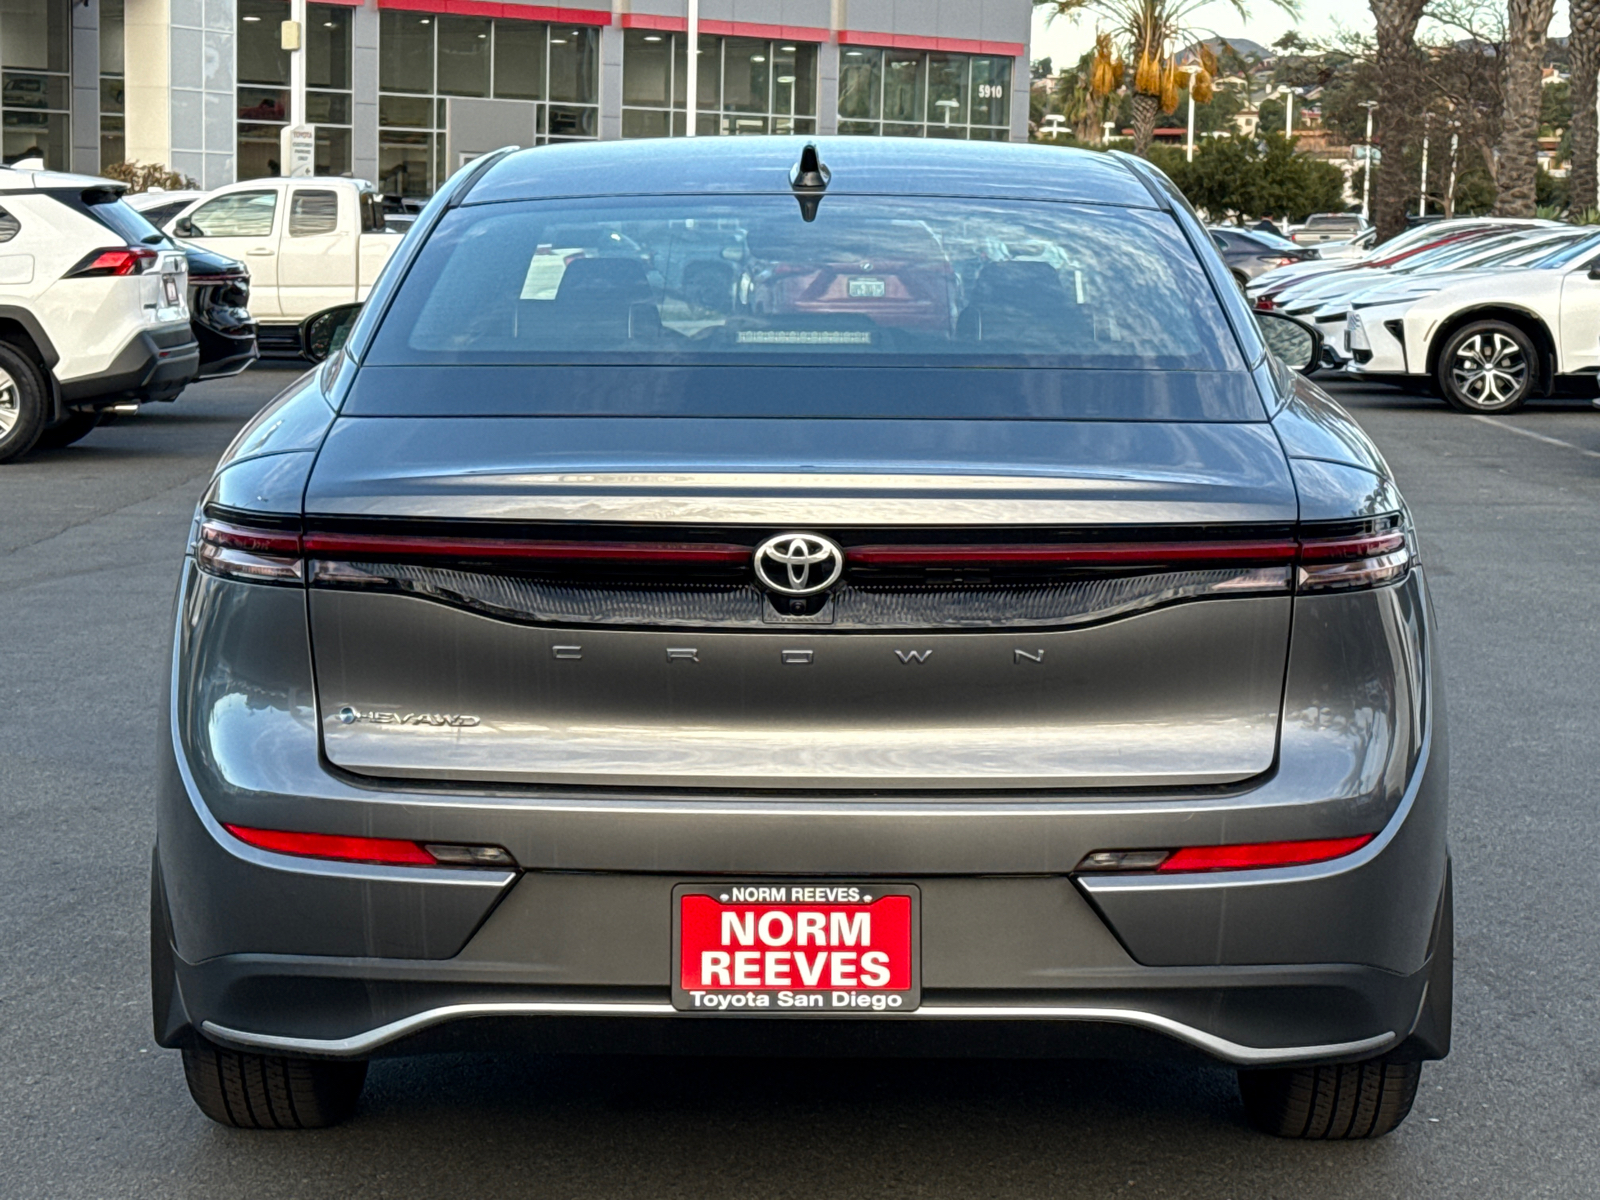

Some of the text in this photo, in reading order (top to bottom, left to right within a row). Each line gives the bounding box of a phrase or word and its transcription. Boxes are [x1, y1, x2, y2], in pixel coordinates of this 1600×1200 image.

[978, 84, 1002, 98] 5910
[552, 645, 1044, 664] CROWN
[732, 887, 860, 902] NORM REEVES
[721, 911, 871, 947] NORM
[701, 951, 891, 987] REEVES
[689, 991, 903, 1010] Toyota San Diego
